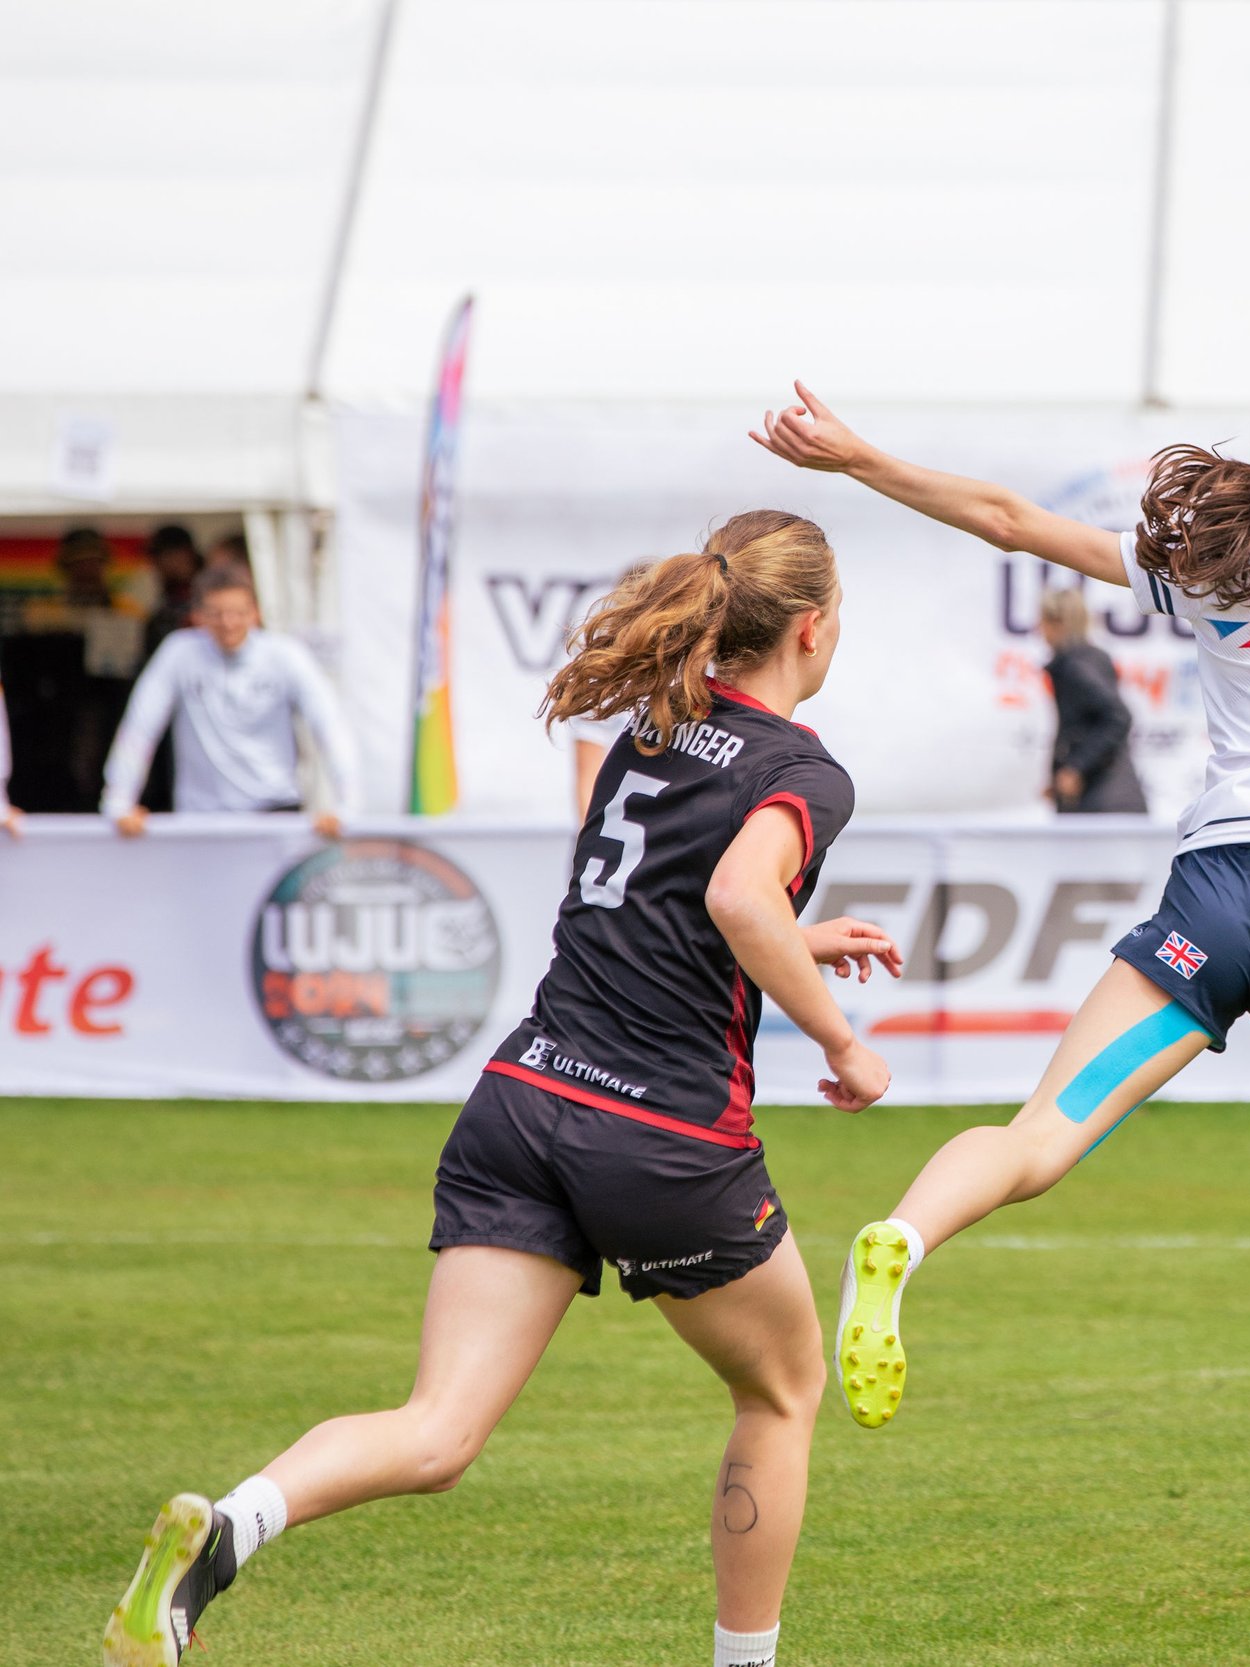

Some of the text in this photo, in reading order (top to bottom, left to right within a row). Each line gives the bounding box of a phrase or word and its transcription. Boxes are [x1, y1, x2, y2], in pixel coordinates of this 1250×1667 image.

[579, 769, 671, 909] 5
[0, 944, 134, 1034] te
[641, 1249, 713, 1272] ULTIMATE
[723, 1462, 758, 1534] 5
